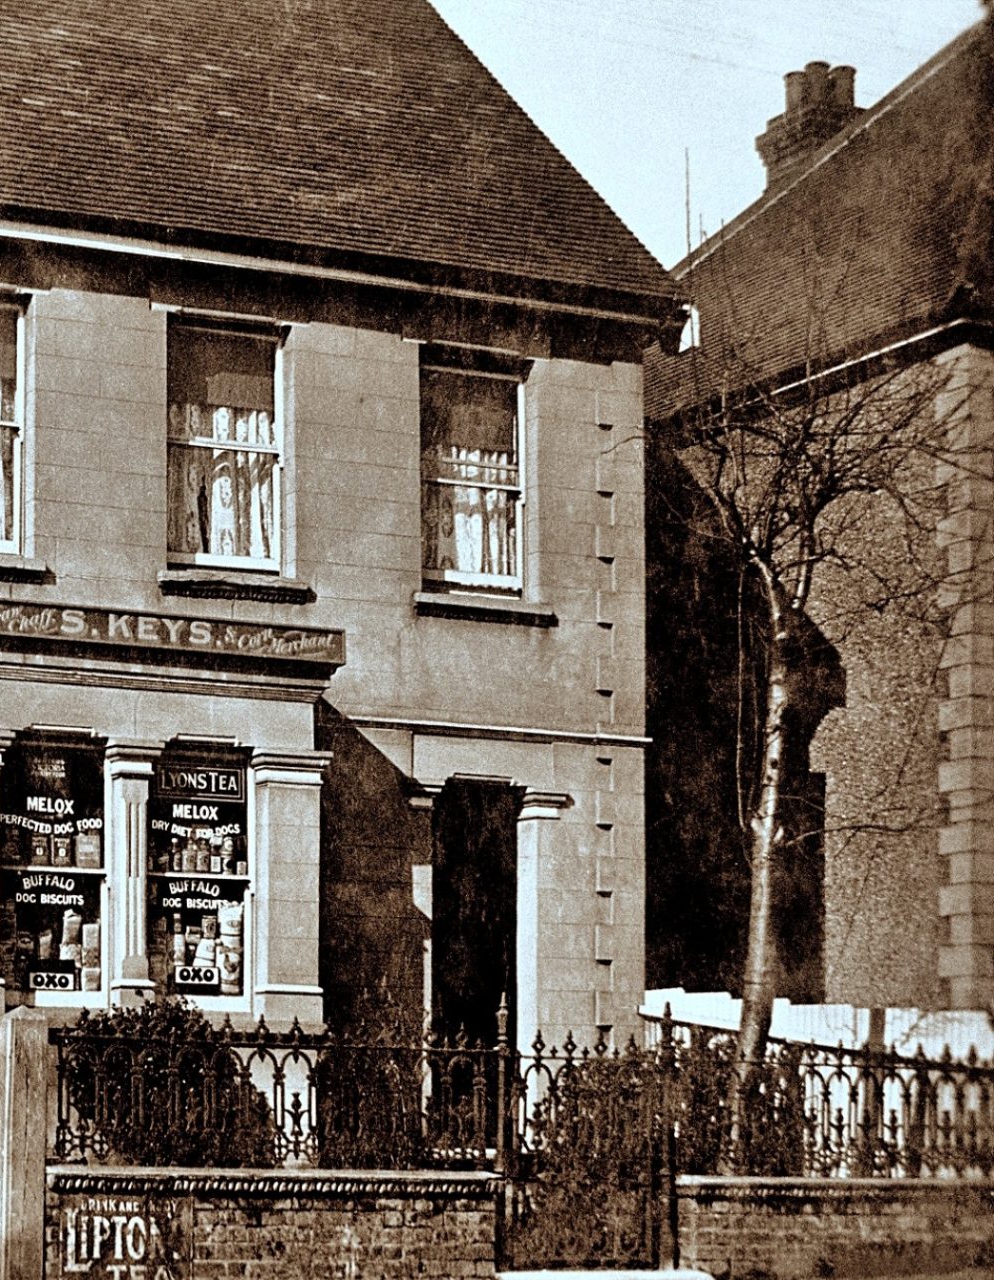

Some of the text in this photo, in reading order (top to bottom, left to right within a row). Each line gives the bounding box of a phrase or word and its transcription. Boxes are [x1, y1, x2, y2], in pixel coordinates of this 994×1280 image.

[60, 609, 99, 636] S.
[209, 770, 238, 793] TEA
[27, 796, 75, 815] MELOX
[172, 804, 219, 821] MELOX
[0, 813, 103, 834] PERFECTED DOG FOOD
[151, 819, 170, 832] DRY
[171, 825, 193, 838] DIET
[22, 874, 75, 892] BUFFALO
[168, 880, 220, 898] BUFFALO
[15, 893, 85, 906] DOG BISCUITS
[162, 897, 182, 908] DOG
[32, 972, 70, 989] OXO
[178, 967, 215, 983] OXO
